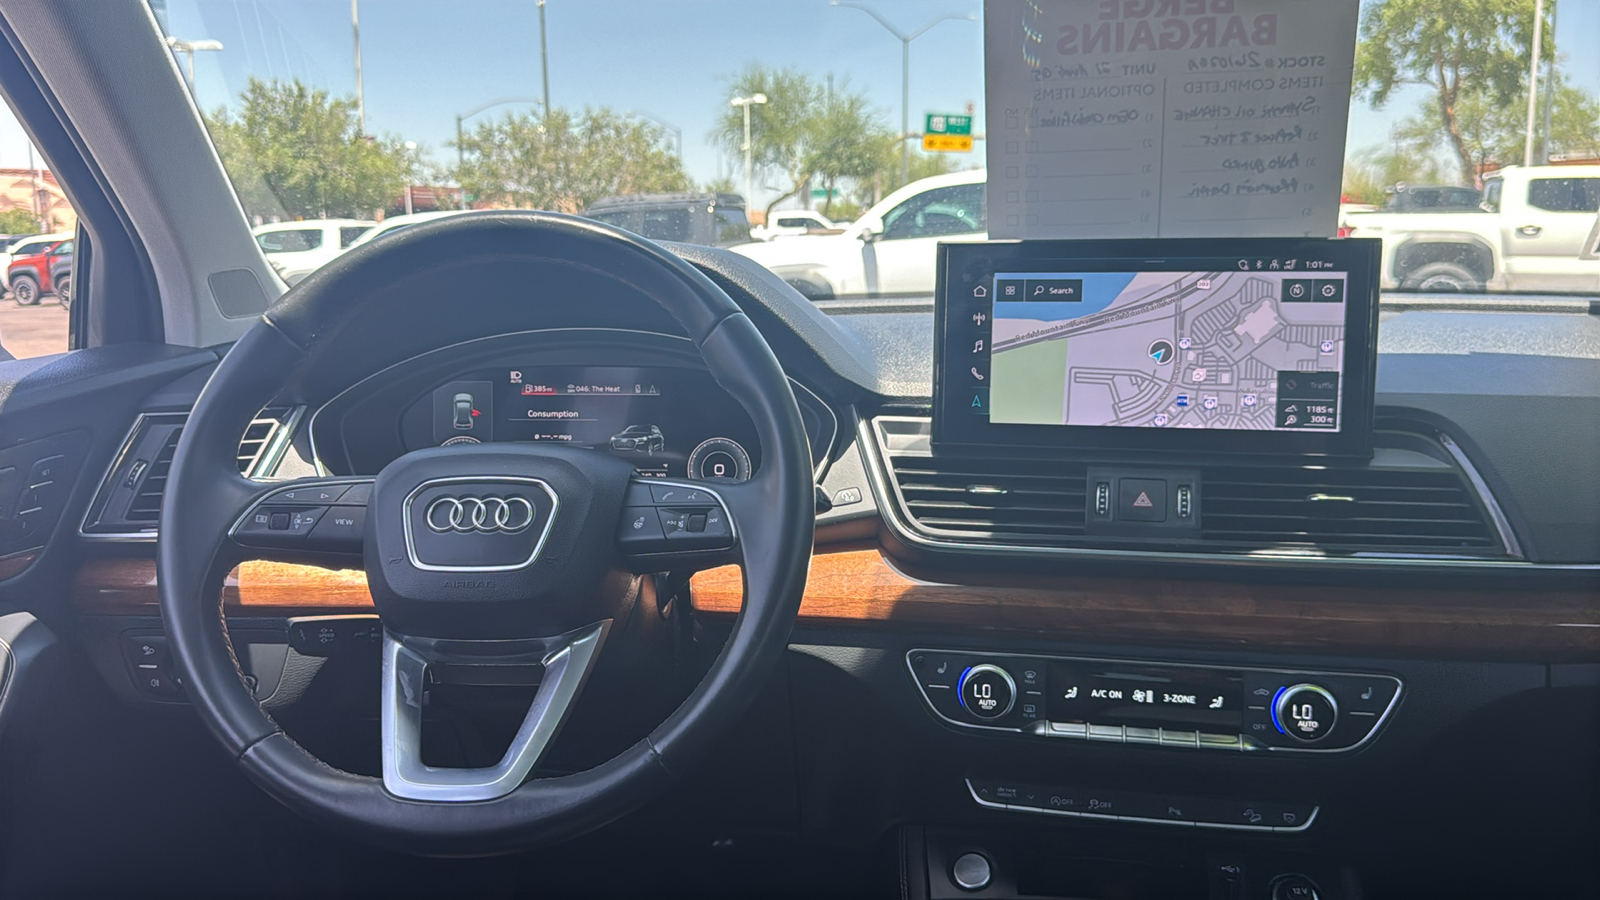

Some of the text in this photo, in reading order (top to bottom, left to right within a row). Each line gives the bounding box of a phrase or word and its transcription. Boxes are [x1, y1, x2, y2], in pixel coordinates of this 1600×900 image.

[1305, 260, 1322, 269] 1:01
[1049, 286, 1074, 295] Search
[1310, 382, 1335, 390] Traffic
[1306, 405, 1327, 413] 1185
[527, 410, 579, 420] Consumption
[1310, 415, 1327, 423] 300
[713, 463, 725, 476] 0
[334, 518, 354, 526] VIEW
[442, 579, 496, 589] AIRBAG
[973, 683, 992, 699] LO
[1091, 689, 1123, 700] A/C ON
[978, 698, 997, 707] AUTO
[1163, 693, 1196, 705] 3-ZONE
[1292, 704, 1313, 720] LO
[1252, 723, 1267, 731] OFF
[1297, 720, 1318, 729] AUTO
